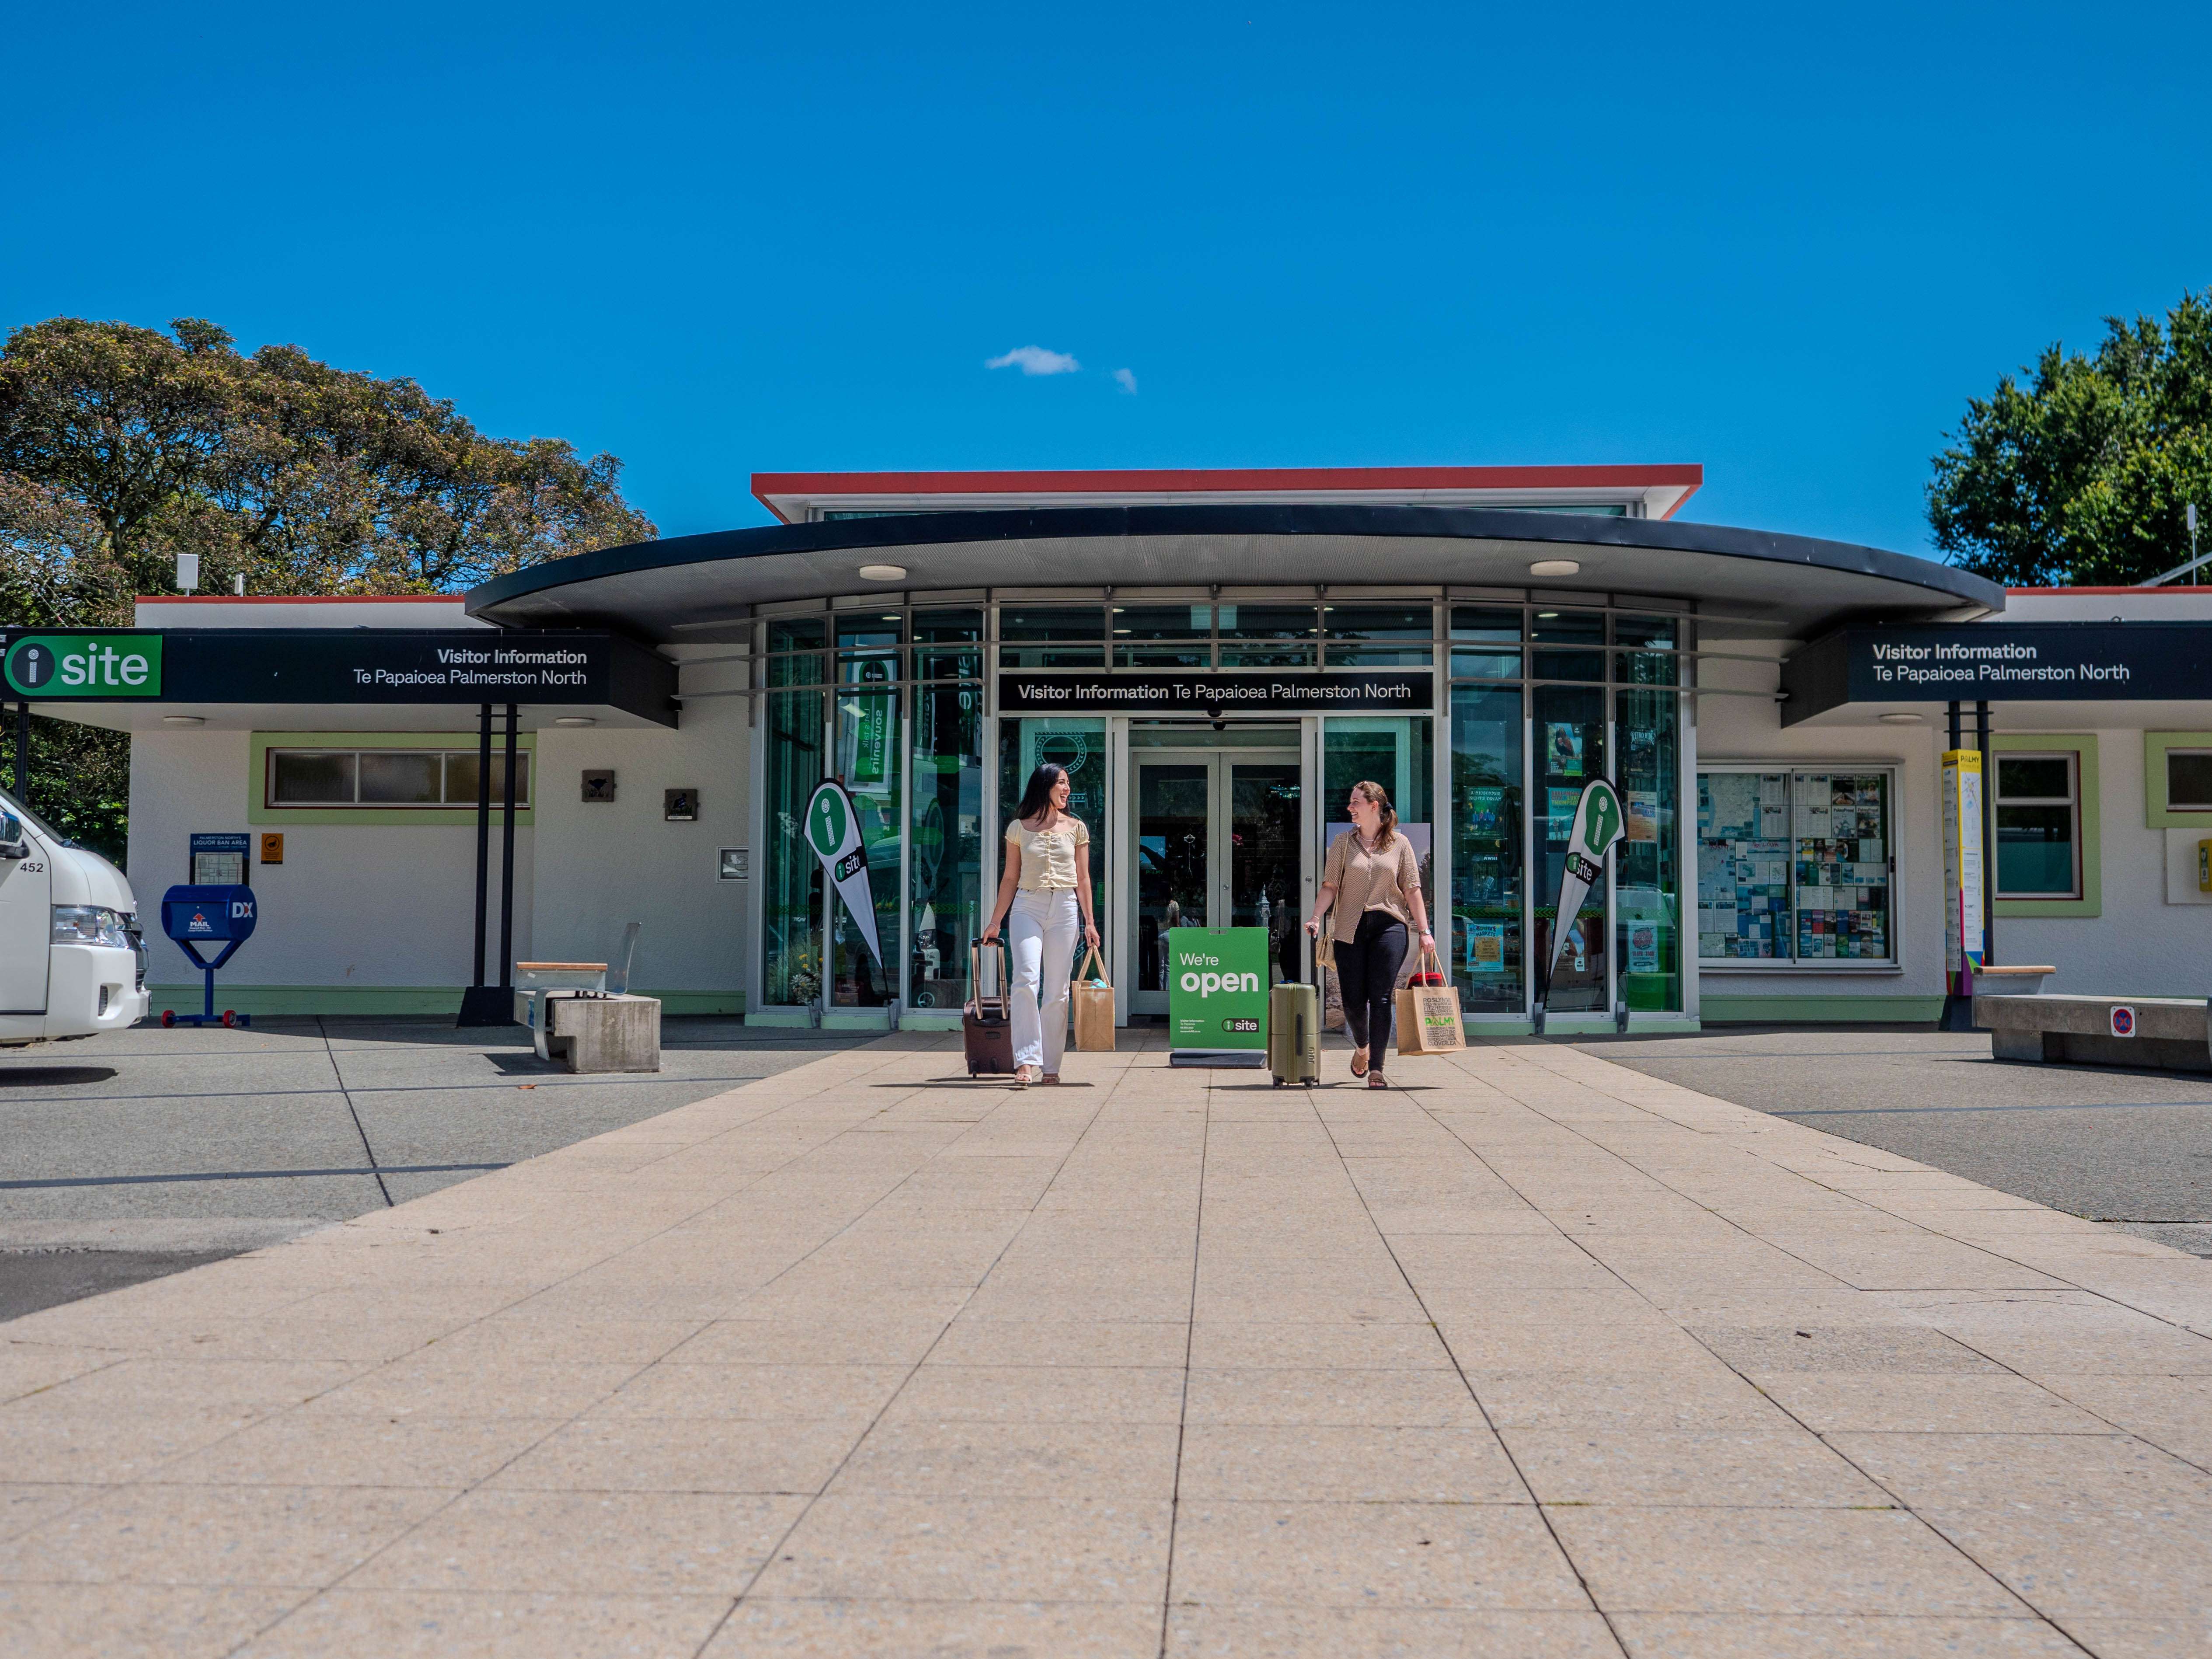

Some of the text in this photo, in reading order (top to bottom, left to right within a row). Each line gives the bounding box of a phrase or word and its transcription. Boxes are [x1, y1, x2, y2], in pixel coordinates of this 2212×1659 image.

[437, 649, 587, 664] Visitor Information
[1873, 643, 2037, 660] Visitor Information
[61, 642, 148, 685] site
[353, 669, 587, 687] Te Papaioea Palmerston North
[1873, 664, 2129, 684] Te Papaioea Palmerston North
[1018, 683, 1411, 701] Visitor Information Te Papaioea Palmerston North
[20, 863, 43, 872] 452
[232, 902, 253, 918] DX
[1180, 953, 1219, 965] We're
[1181, 972, 1258, 998] open
[1235, 1019, 1257, 1031] site
[1425, 1017, 1455, 1026] PALMY
